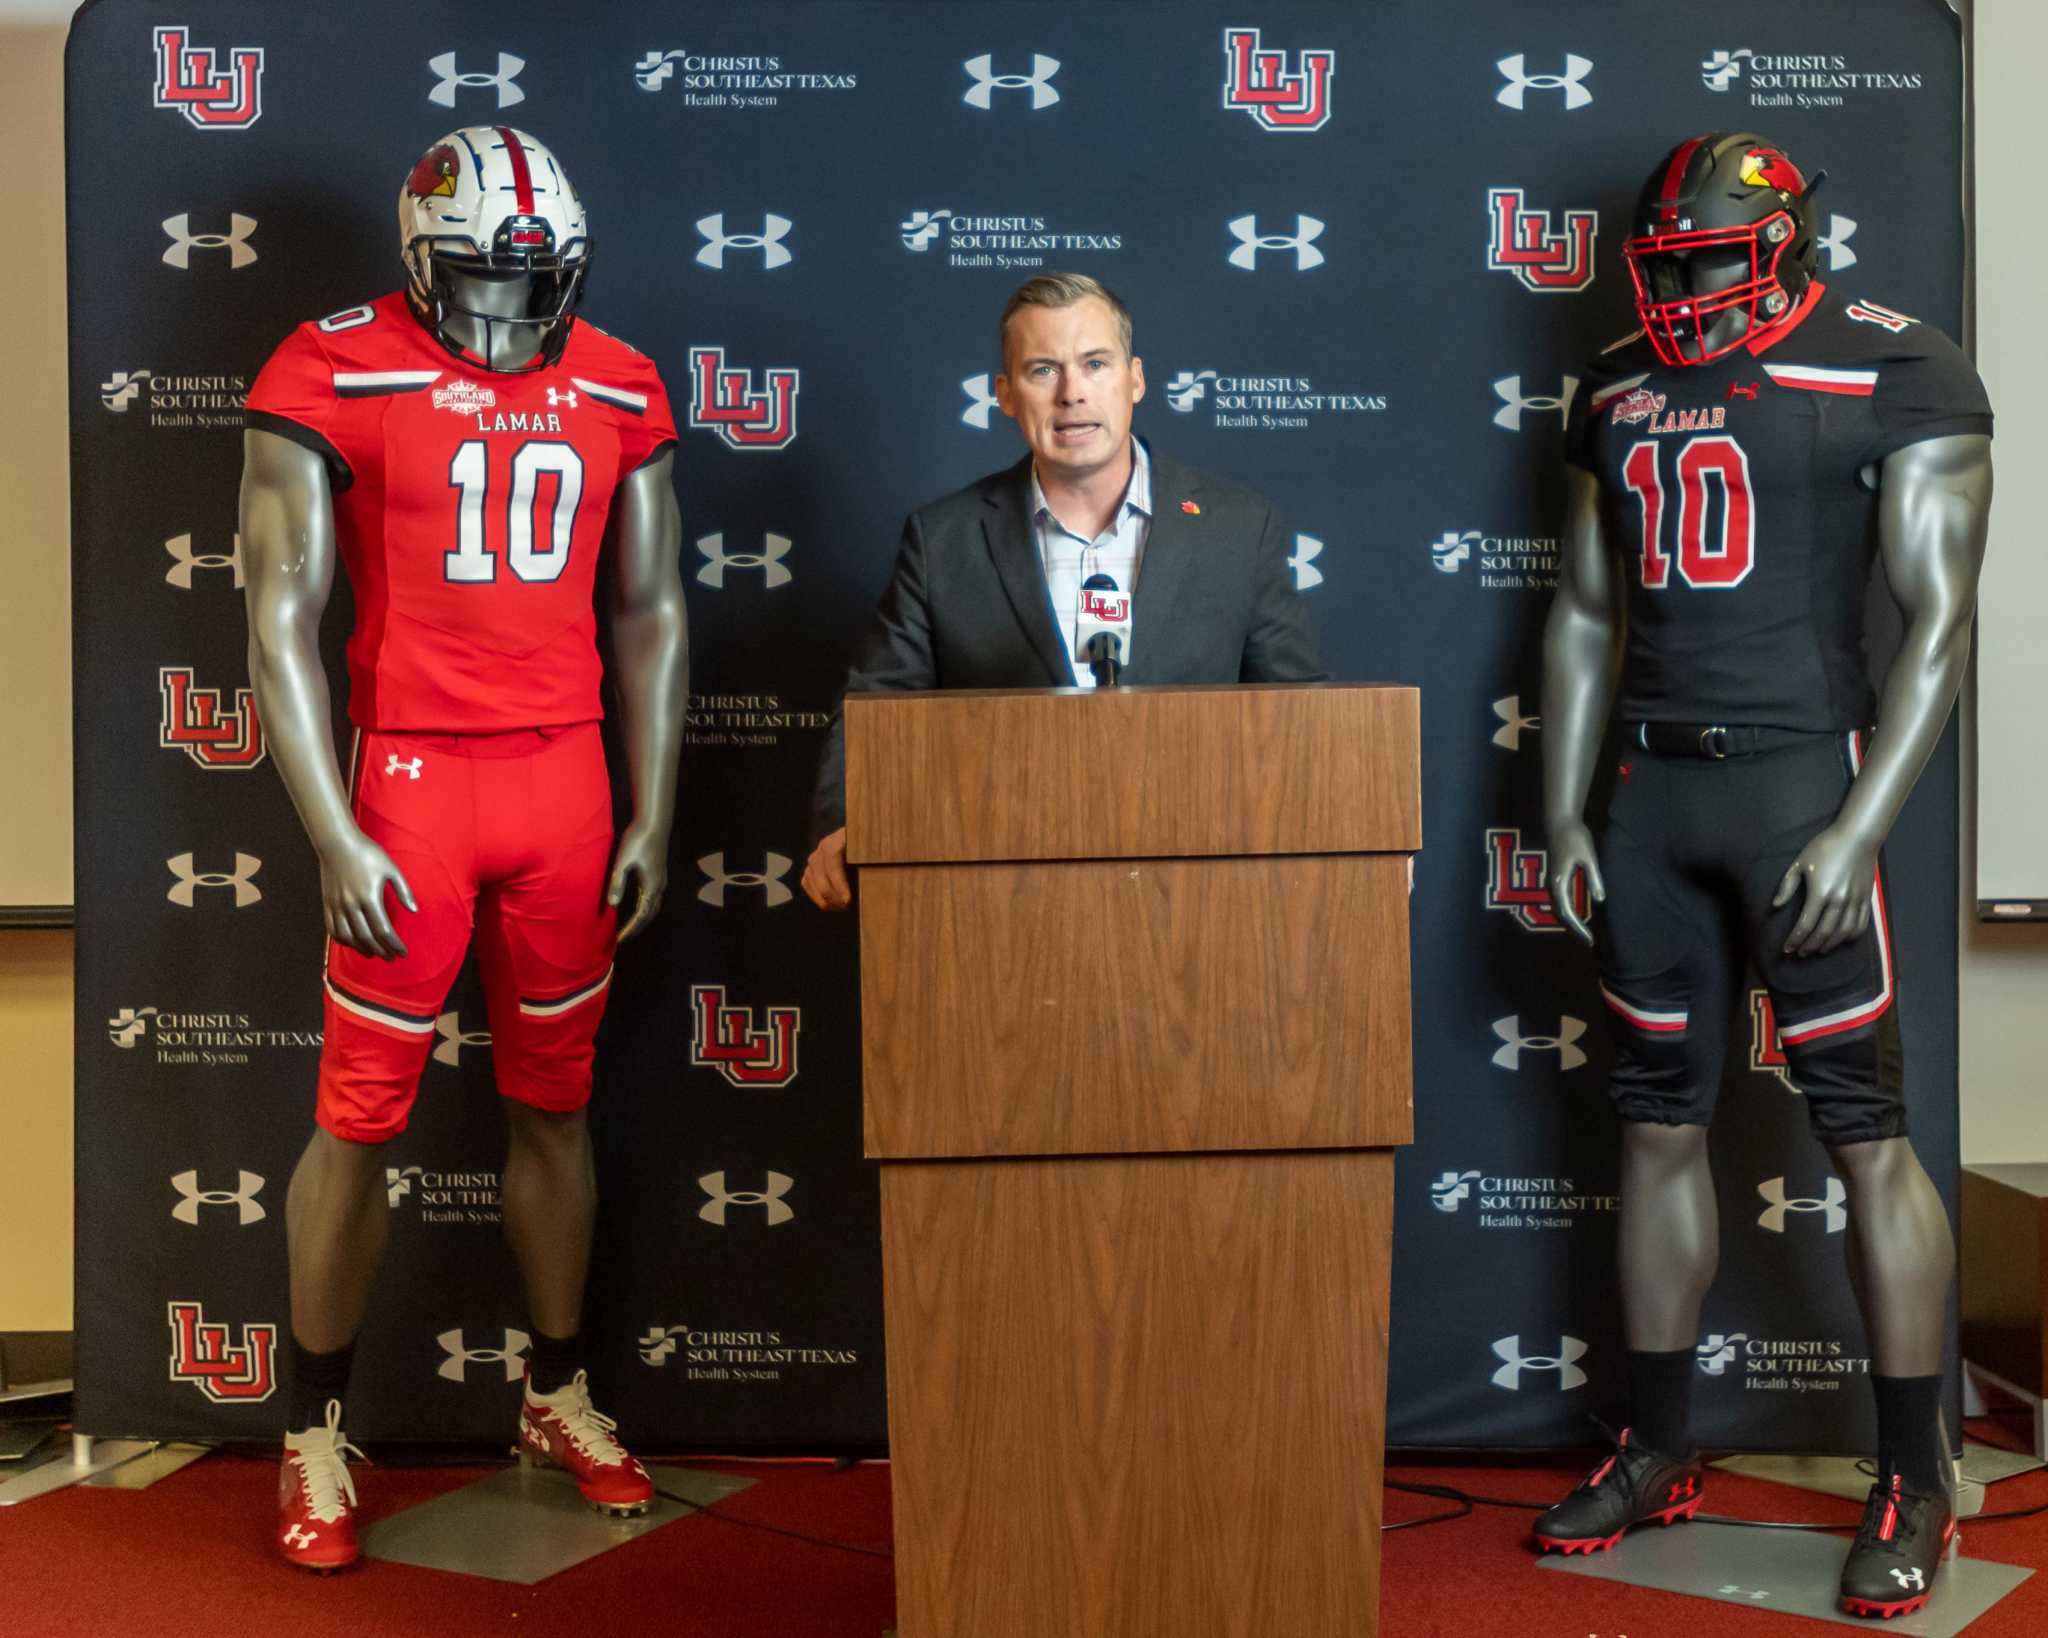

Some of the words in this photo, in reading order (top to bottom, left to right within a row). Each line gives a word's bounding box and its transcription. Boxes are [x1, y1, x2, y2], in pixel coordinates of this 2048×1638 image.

[684, 56, 779, 71] CHRISTUS
[1751, 56, 1845, 71] CHRISTUS
[154, 26, 265, 130] LU
[684, 74, 796, 89] SOUTHEAST
[797, 74, 858, 89] TEXAS
[1224, 28, 1335, 131] LU
[1751, 74, 1862, 89] SOUTHEAST
[1863, 74, 1923, 89] TEXAS
[684, 93, 727, 106] Health
[730, 93, 778, 108] System
[1751, 93, 1793, 106] Health
[1796, 93, 1844, 108] System
[950, 216, 1044, 231] CHRISTUS
[951, 235, 1060, 249] SOUTHEAST
[1062, 235, 1122, 249] TEXAS
[1488, 187, 1598, 292] LU
[951, 254, 992, 267] Health
[996, 254, 1043, 268] System
[150, 376, 244, 391] CHRISTUS
[1215, 377, 1309, 392] CHRISTUS
[151, 394, 247, 409] SOUTHEAS
[690, 347, 799, 449] LU
[1216, 395, 1326, 410] SOUTHEAST
[1327, 395, 1387, 410] TEXAS
[151, 413, 193, 426] Health
[197, 413, 244, 428] System
[477, 412, 562, 432] LAMAR
[1216, 414, 1258, 427] Health
[1262, 414, 1308, 430] System
[1647, 407, 1726, 433] LAMAR
[444, 439, 586, 584] 10
[1621, 435, 1757, 590] 10
[1480, 538, 1559, 553] CHRISTU
[1481, 574, 1522, 588] Health
[1527, 574, 1559, 590] Syste
[1080, 590, 1129, 622] LU
[160, 667, 266, 770] LU
[686, 713, 795, 728] SOUTHEAST
[685, 732, 727, 745] Health
[731, 732, 777, 747] System
[156, 1014, 248, 1028] CHRISTUS
[157, 1031, 266, 1046] SOUTHEAST
[266, 1031, 324, 1046] TEXAS
[692, 985, 801, 1088] LU
[157, 1050, 199, 1063] Health
[203, 1050, 248, 1066] System
[421, 1173, 498, 1188] CHRISTU
[1480, 1177, 1574, 1192] CHRISTUS
[422, 1191, 498, 1205] SOUTHE
[1480, 1195, 1589, 1210] SOUTHEAST
[423, 1210, 464, 1223] Health
[468, 1210, 501, 1225] Syste
[1480, 1214, 1522, 1228] Health
[1526, 1214, 1573, 1230] System
[686, 1331, 781, 1346] CHRISTUS
[167, 1301, 277, 1404] LU
[1746, 1340, 1841, 1355] CHRISTUS
[687, 1349, 796, 1363] SOUTHEAST
[797, 1350, 857, 1364] TEXAS
[1746, 1358, 1856, 1373] SOUTHEAST
[688, 1367, 729, 1380] Health
[732, 1367, 779, 1382] System
[1746, 1377, 1788, 1390] Health
[1792, 1377, 1839, 1392] System
